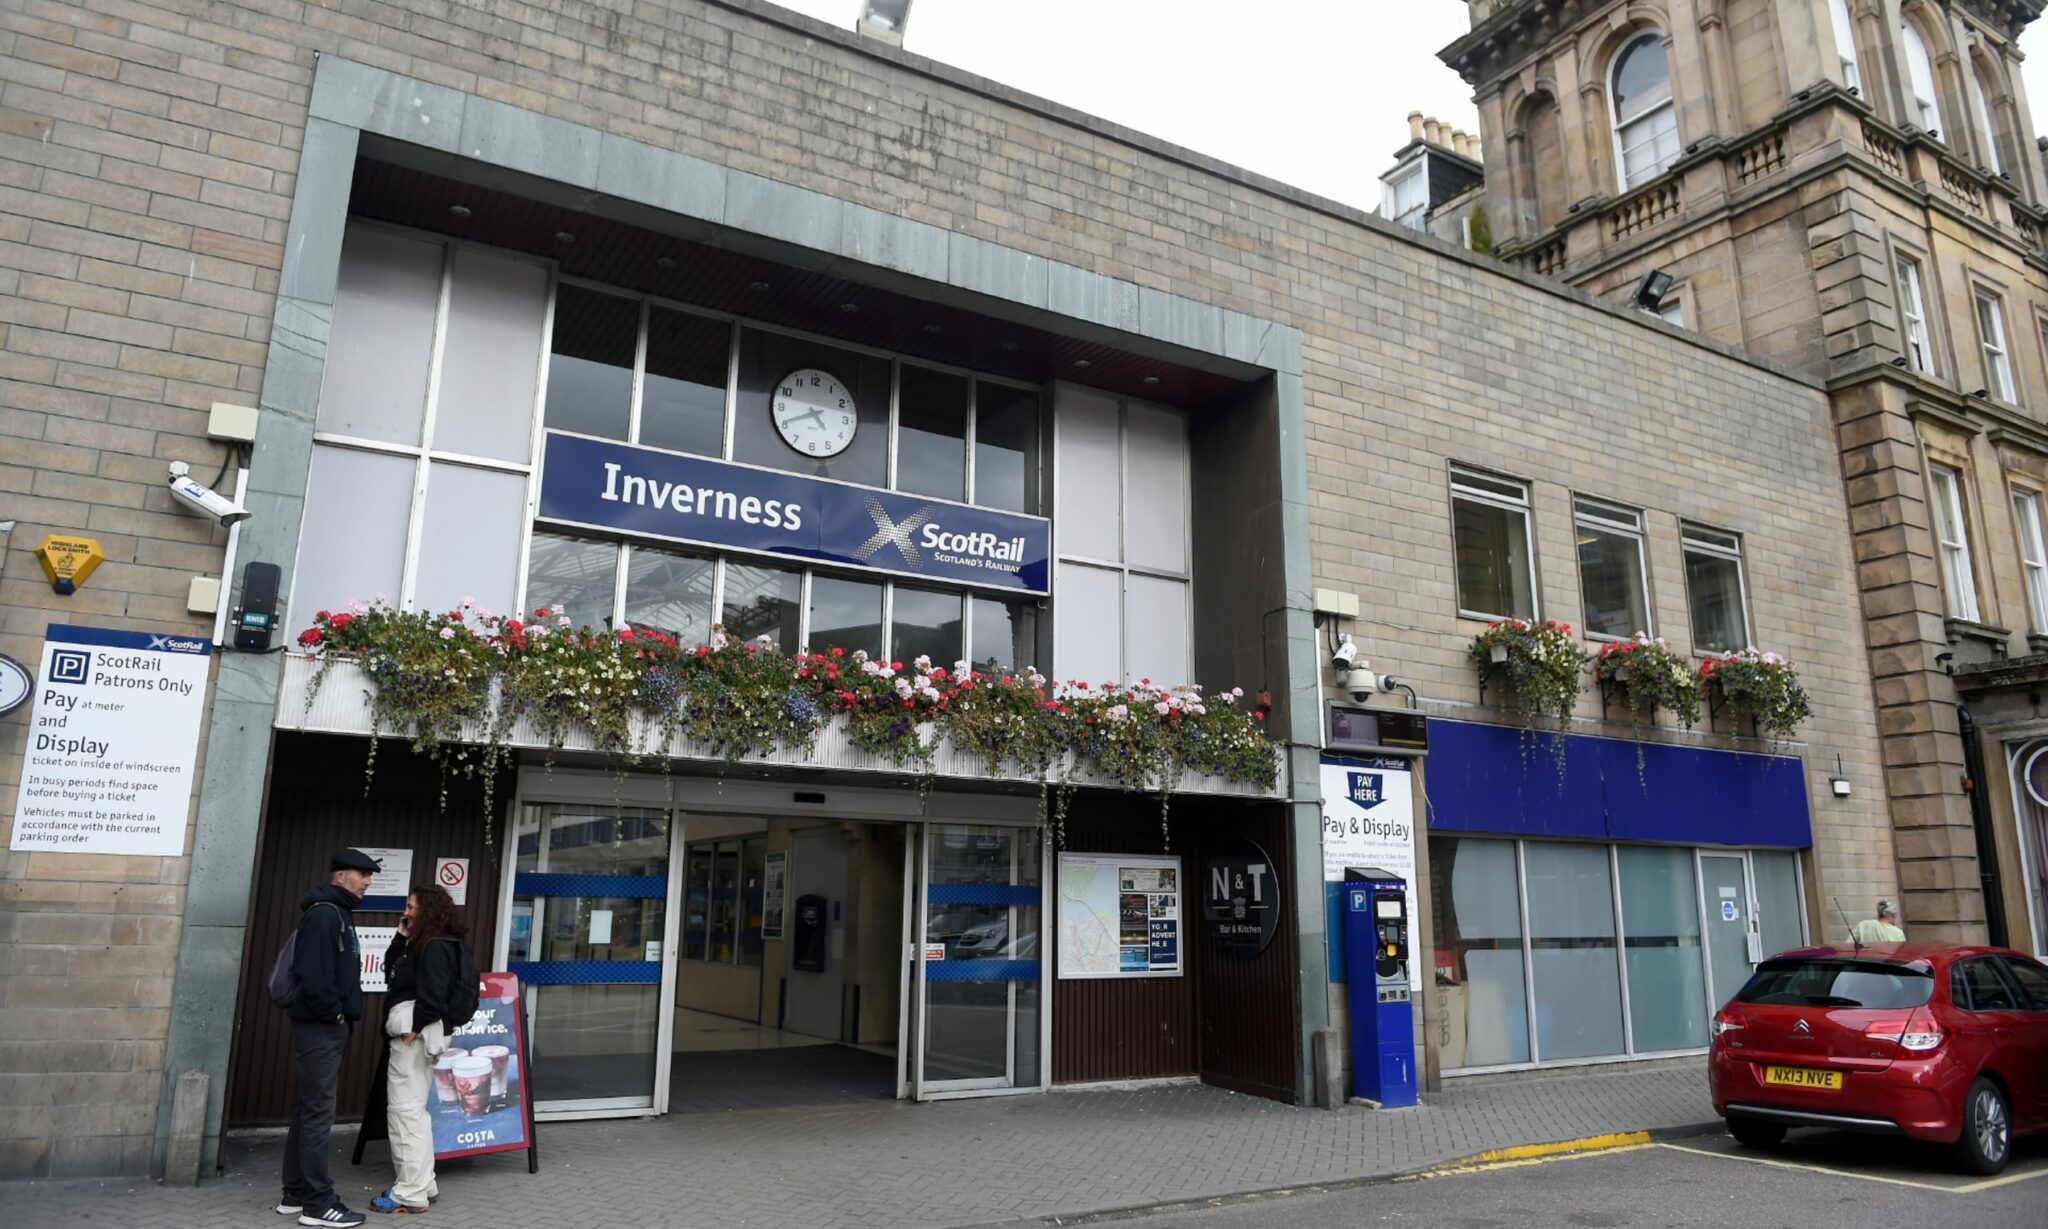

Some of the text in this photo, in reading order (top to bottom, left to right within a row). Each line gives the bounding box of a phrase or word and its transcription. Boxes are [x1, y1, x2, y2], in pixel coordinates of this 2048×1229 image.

[796, 378, 802, 388] 11
[810, 376, 820, 386] 12
[782, 387, 792, 397] 10
[830, 385, 833, 394] 1
[778, 403, 784, 412] 9
[839, 399, 845, 408] 2
[782, 420, 788, 429] 8
[842, 416, 848, 425] 3
[793, 434, 799, 444] 7
[837, 432, 843, 440] 4
[809, 442, 815, 451] 6
[825, 441, 832, 450] 5
[601, 462, 801, 531] Inverness
[920, 522, 1025, 562] ScotRail
[934, 552, 1021, 573] SCOTLAND'S RAILWAY
[167, 640, 203, 650] ScotRail
[62, 658, 78, 676] P
[97, 653, 161, 671] ScotRail
[95, 672, 193, 696] Patrons Only
[44, 690, 78, 711] Pay
[95, 703, 125, 711] meter
[39, 716, 67, 728] and
[36, 734, 109, 758] Display
[32, 757, 181, 773] ticket on inside of windscreen
[29, 776, 158, 792] In busy periods find space
[1357, 776, 1373, 787] PAY
[27, 787, 60, 797] before
[62, 790, 96, 802] buying
[107, 793, 136, 802] ticket
[1354, 788, 1377, 801] HERE
[24, 807, 65, 817] Vehicles
[95, 810, 108, 819] be
[110, 811, 143, 821] parked
[146, 813, 155, 821] in
[21, 821, 161, 834] accordance with the current
[1324, 816, 1409, 840] Pay & Display
[19, 832, 89, 843] parking order
[1212, 864, 1266, 901] N & T
[1354, 894, 1363, 908] P
[1220, 924, 1231, 933] Bar
[1238, 925, 1261, 934] Kitchen
[488, 1020, 508, 1033] ice.
[1774, 1068, 1834, 1086] NX13 NVE
[457, 1130, 495, 1144] COSTA
